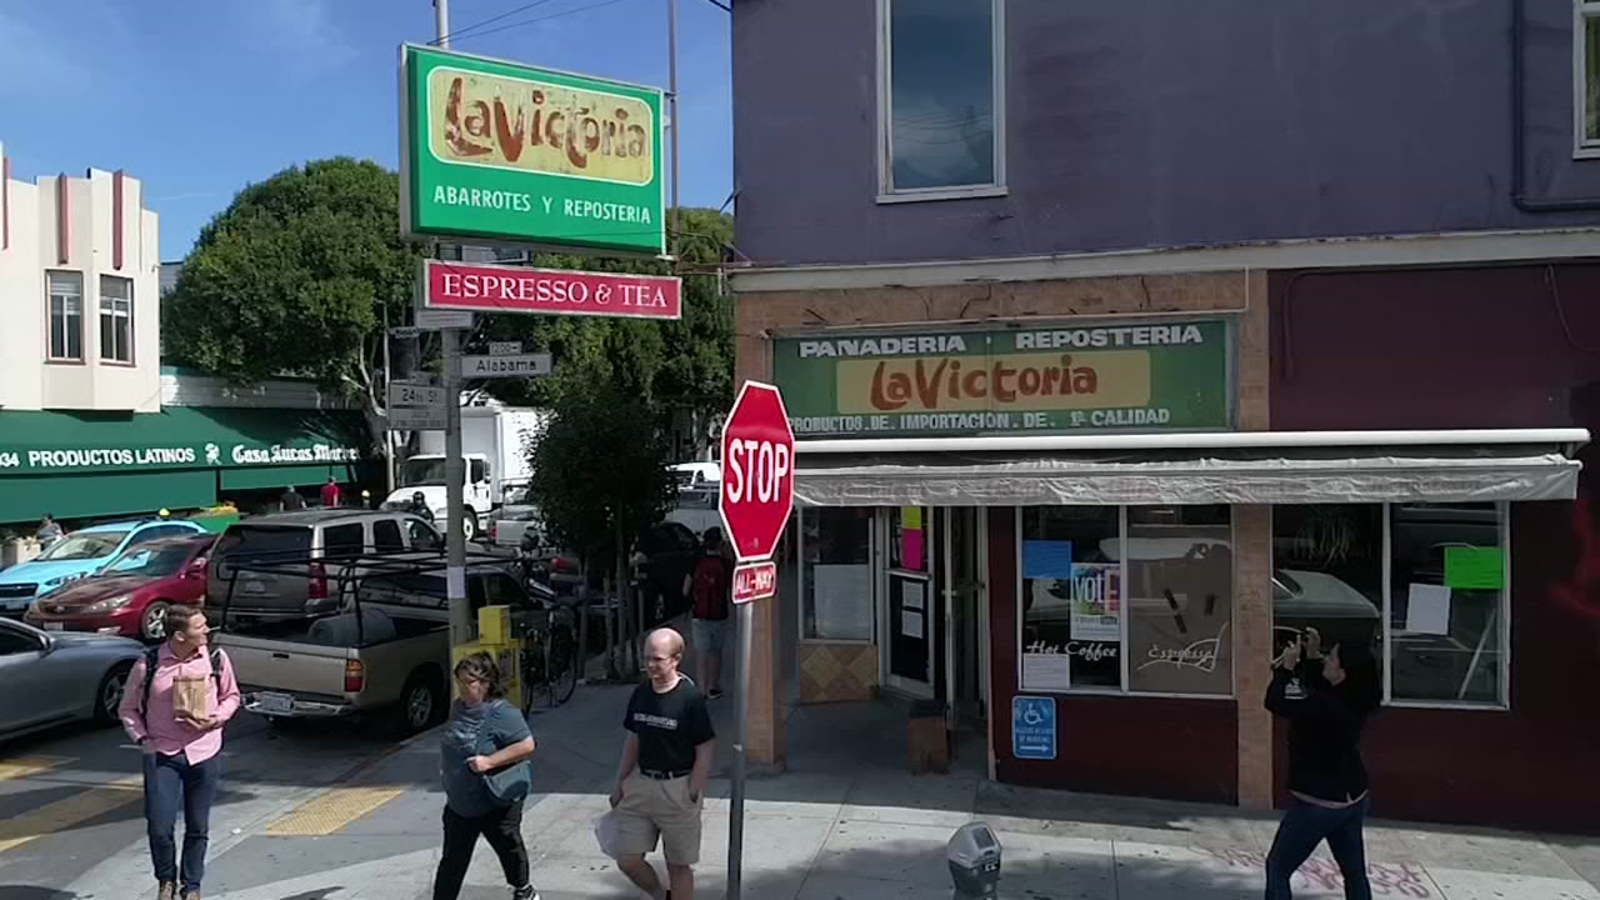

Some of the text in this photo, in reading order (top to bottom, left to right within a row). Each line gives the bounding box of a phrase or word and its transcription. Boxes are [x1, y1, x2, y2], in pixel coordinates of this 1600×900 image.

[434, 185, 651, 225] ABARROTES Y REPOSTERIA
[443, 273, 668, 308] ESPRESSO & TEA
[800, 325, 1203, 357] PANADERIA REPOSTERIA
[476, 359, 537, 373] Alabama
[1091, 408, 1170, 426] CALIDAD
[28, 449, 134, 467] PRODUCTOS
[135, 448, 196, 465] LATINOS
[231, 444, 271, 464] Casa
[270, 444, 313, 463] Lucas
[727, 438, 788, 502] STOP
[1064, 641, 1117, 661] Coffee
